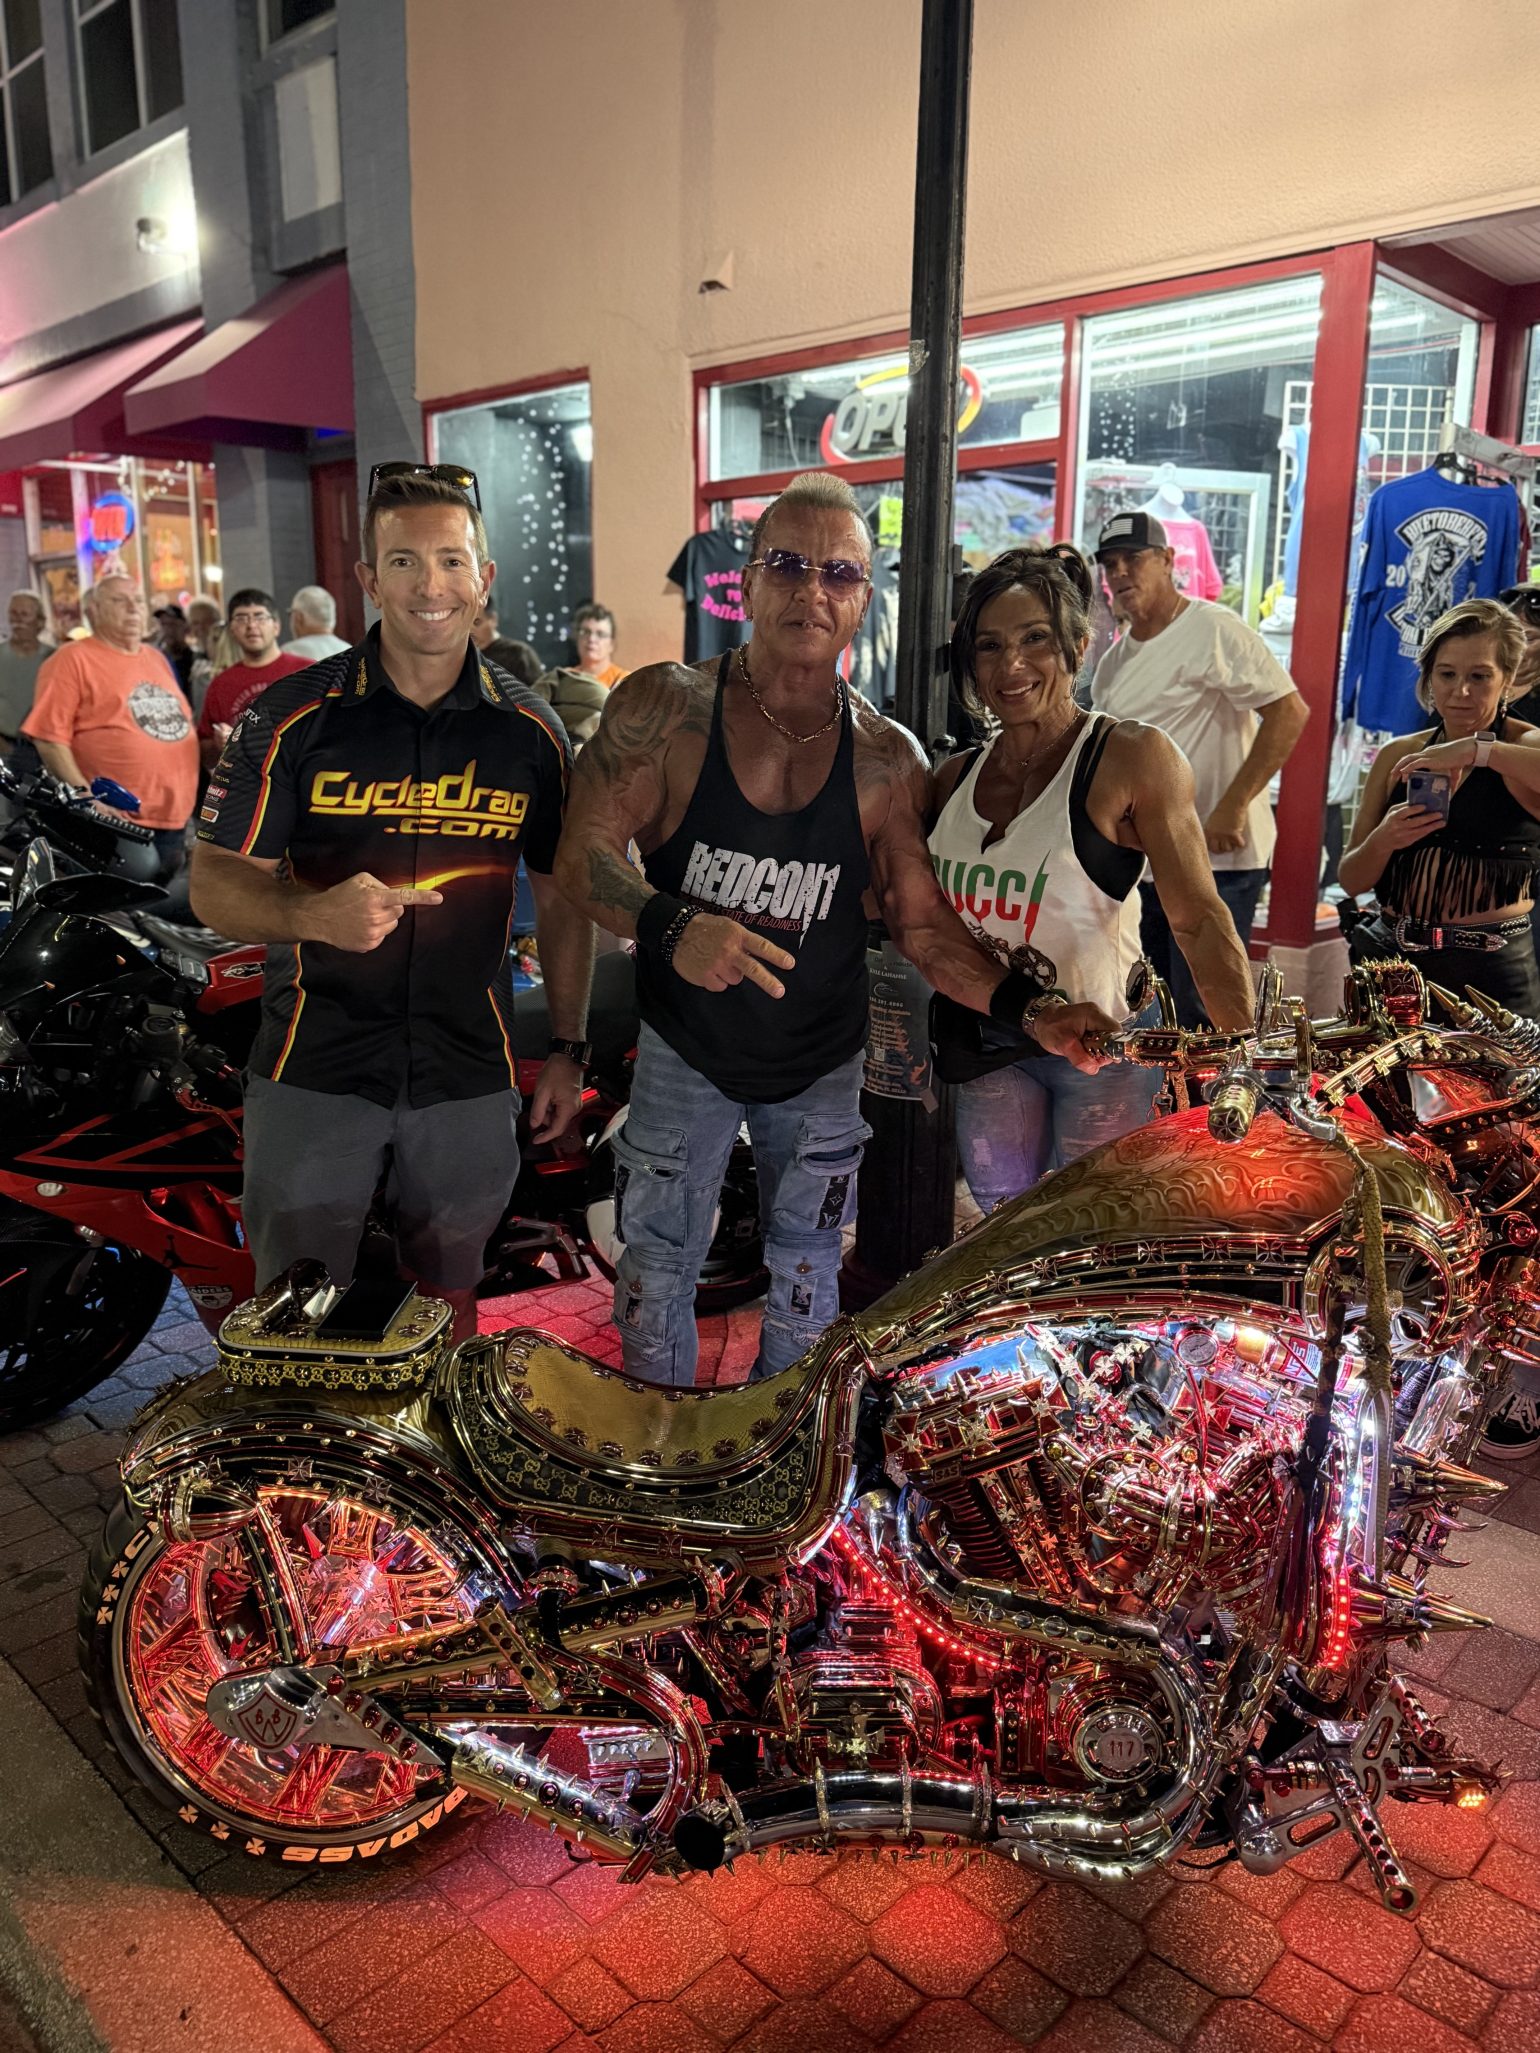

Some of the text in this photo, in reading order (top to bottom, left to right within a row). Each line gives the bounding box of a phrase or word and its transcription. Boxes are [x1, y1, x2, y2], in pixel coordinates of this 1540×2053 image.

[383, 817, 520, 840] .com
[681, 840, 841, 940] REDCON1
[744, 912, 757, 924] OF
[757, 915, 803, 932] READINESS
[1109, 1740, 1134, 1757] 117
[282, 1785, 469, 1863] BADASS
